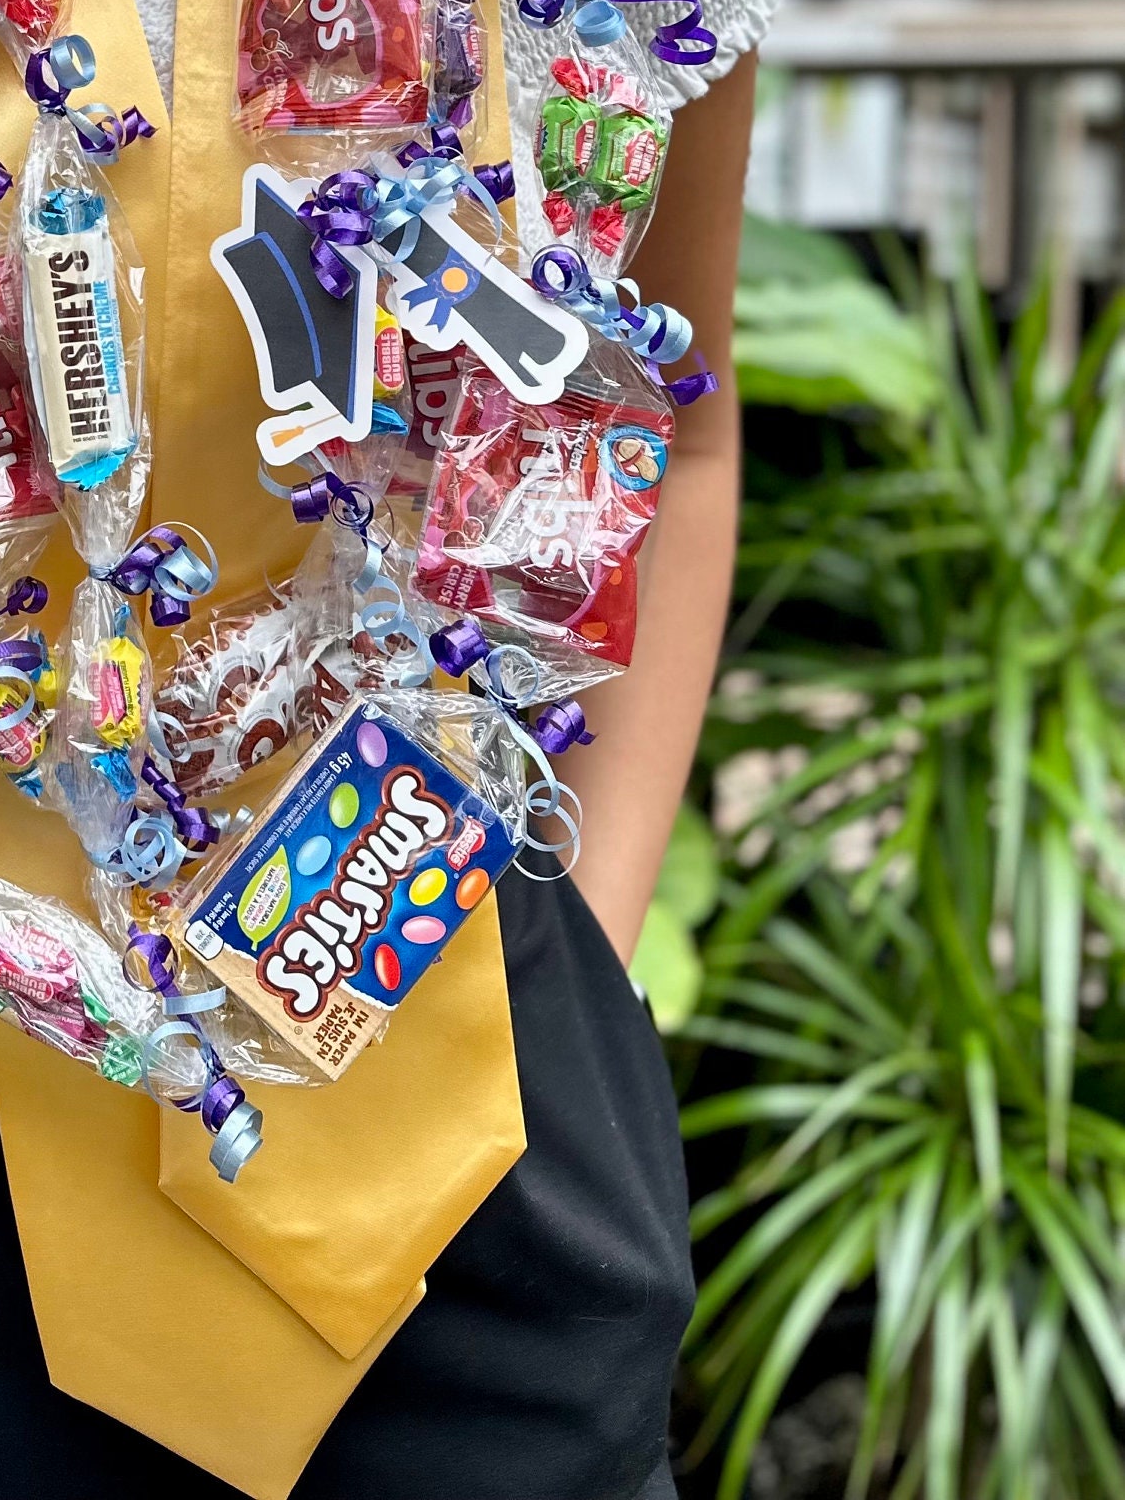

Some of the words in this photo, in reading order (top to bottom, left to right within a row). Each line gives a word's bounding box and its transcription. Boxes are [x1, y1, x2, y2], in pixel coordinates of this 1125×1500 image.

[46, 247, 112, 436] HERSHEY'S
[101, 340, 121, 394] COOKIES
[381, 332, 391, 382] DUBBLE
[391, 332, 400, 382] BUBBLE
[437, 563, 462, 604] CERISE
[92, 668, 101, 720] BUBBLE
[326, 759, 342, 774] g
[333, 749, 355, 768] 45
[309, 766, 330, 792] CHOCOLAT
[320, 771, 337, 790] CANDY
[297, 793, 310, 806] LAIT
[300, 800, 314, 816] MILK
[309, 785, 326, 805] COATED
[282, 811, 306, 839] CHOCOLATE
[259, 830, 280, 854] COQUILLE
[243, 855, 259, 873] SUCRE
[256, 867, 275, 898] NATURELS
[221, 890, 233, 903] Pour
[227, 901, 237, 911] Per
[258, 898, 276, 926] NATURAL
[0, 965, 47, 991] BUBBLE
[341, 1000, 359, 1018] JE
[350, 1009, 369, 1030] I'M
[311, 1002, 344, 1044] PAPIER
[327, 1015, 349, 1042] SUIS
[315, 1039, 334, 1060] EN
[326, 1028, 356, 1067] PAPER
